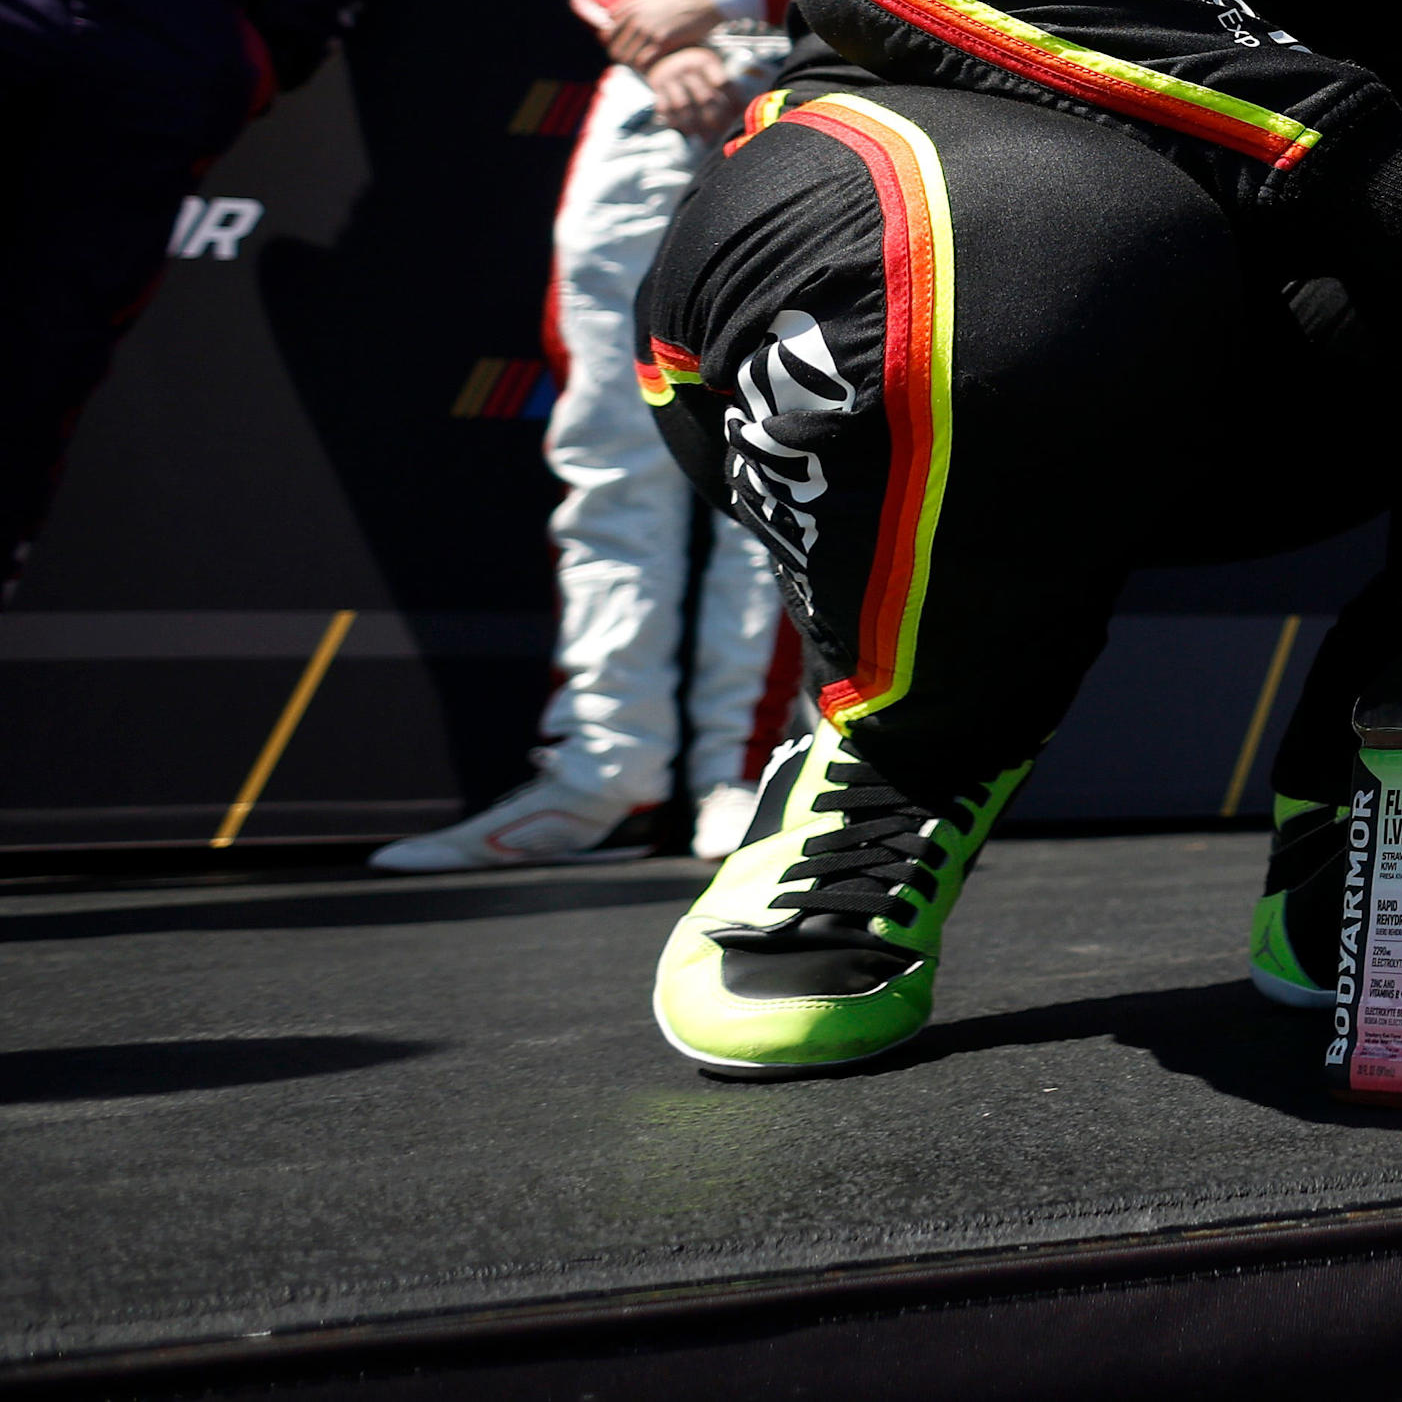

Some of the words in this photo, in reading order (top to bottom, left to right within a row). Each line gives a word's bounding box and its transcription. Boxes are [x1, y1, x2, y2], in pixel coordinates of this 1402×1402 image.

[1380, 862, 1398, 871] KIWI
[1376, 899, 1398, 912] RAPID
[1325, 789, 1374, 1067] BODYARMOR
[1364, 1006, 1396, 1018] ELECTROLYTE
